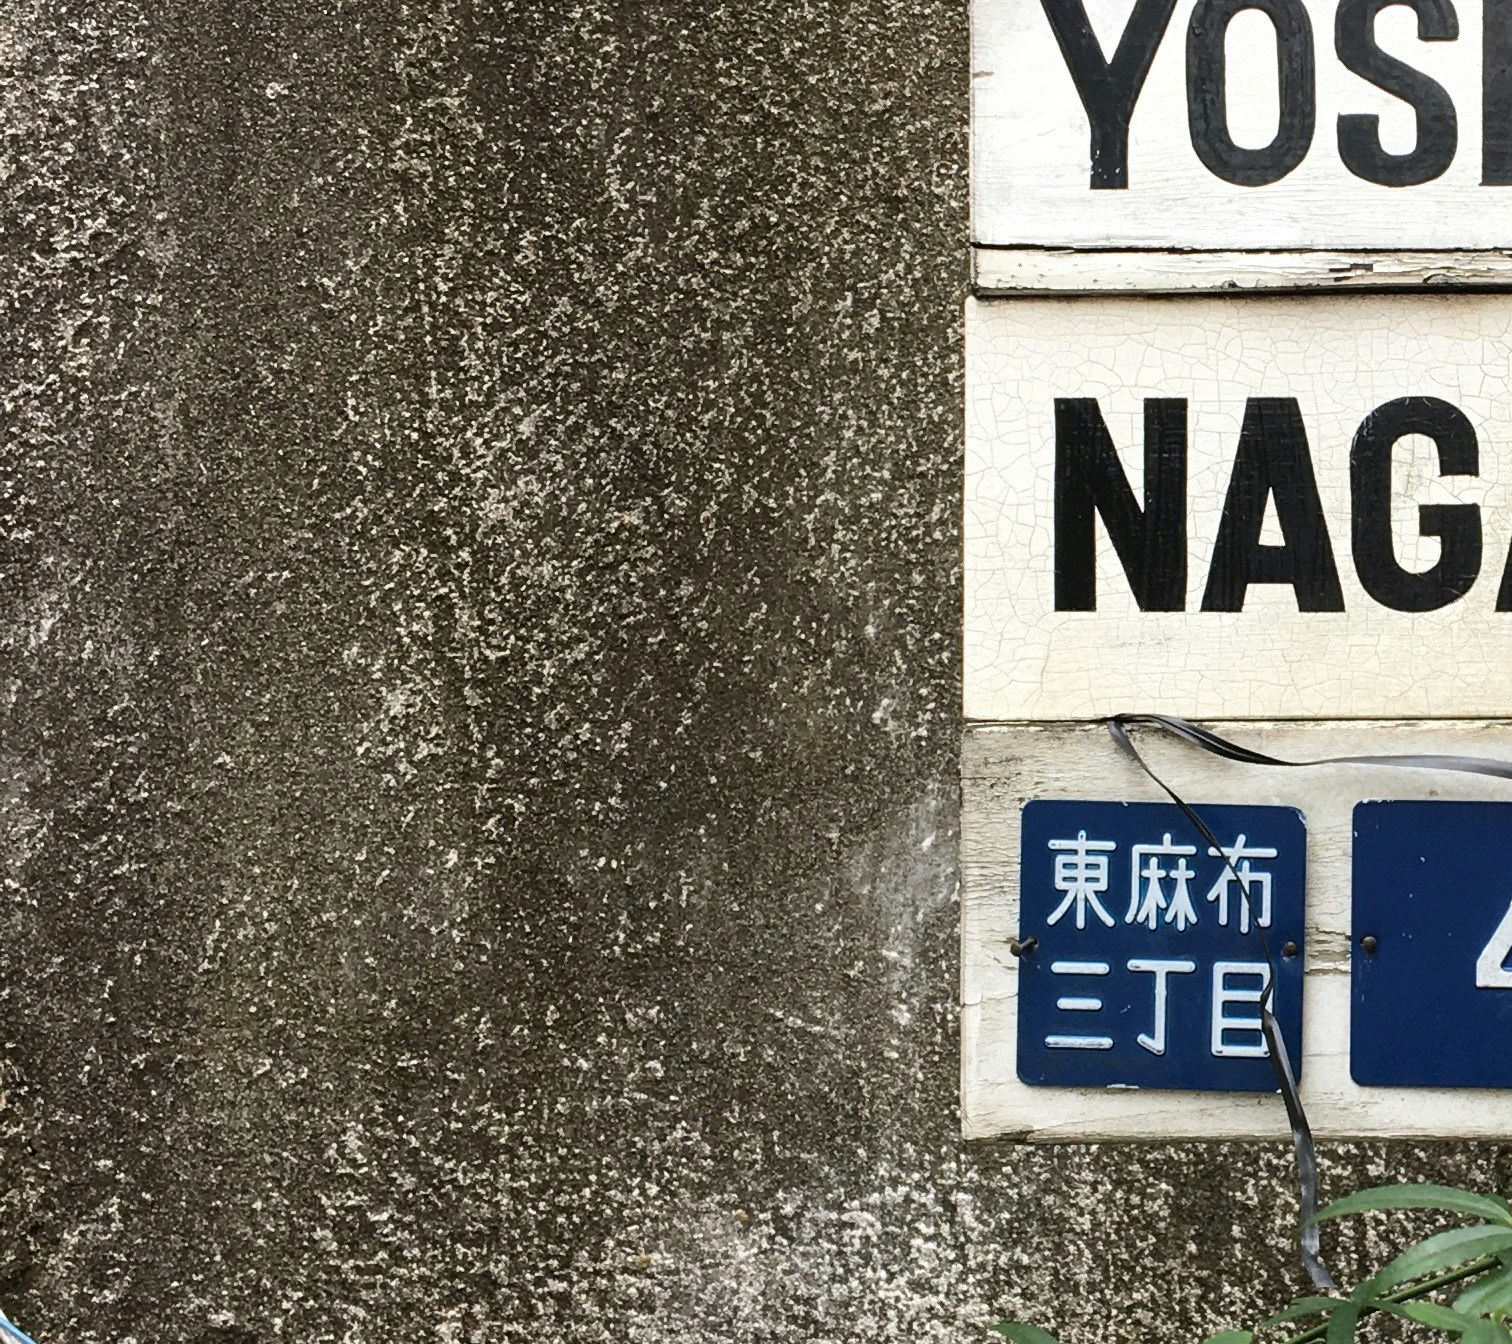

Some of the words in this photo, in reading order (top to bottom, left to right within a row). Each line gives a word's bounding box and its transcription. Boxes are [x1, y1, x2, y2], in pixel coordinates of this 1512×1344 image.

[1046, 830, 1278, 934] 東麻布
[1044, 959, 1273, 1058] 三丁目
